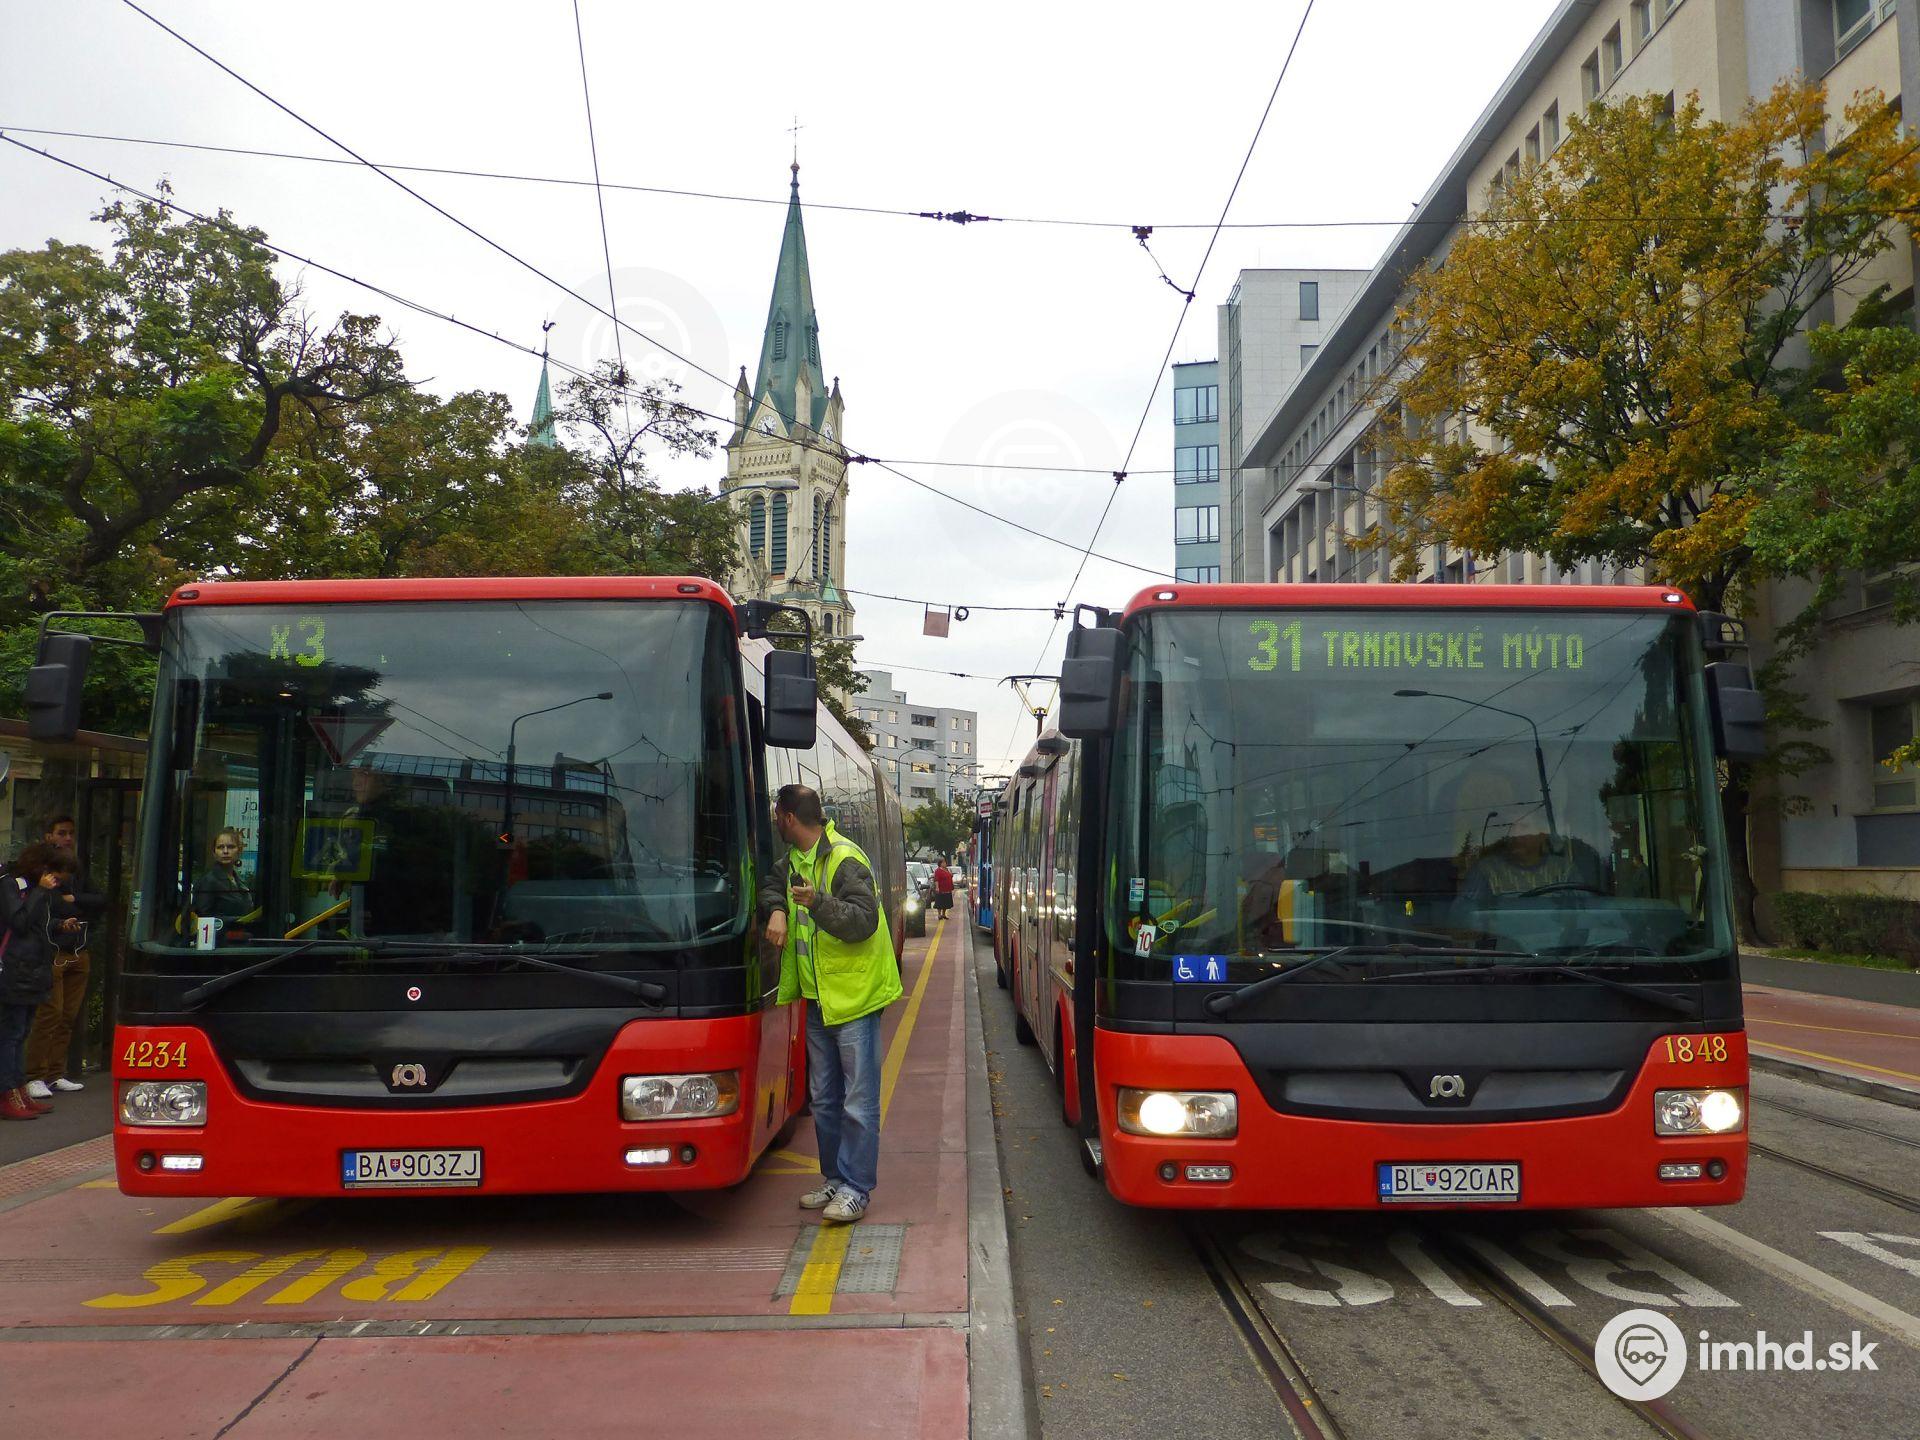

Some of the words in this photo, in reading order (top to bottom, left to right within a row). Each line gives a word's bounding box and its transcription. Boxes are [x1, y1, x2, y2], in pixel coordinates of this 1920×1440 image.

[1248, 620, 1301, 671] 31
[1322, 625, 1484, 668] TRNAVSKÉ
[1503, 625, 1584, 669] MÝTO
[202, 924, 209, 944] 1
[1139, 931, 1152, 952] 10
[123, 1041, 187, 1068] 4234
[1664, 1036, 1728, 1063] 1848
[81, 1246, 492, 1309] BUS
